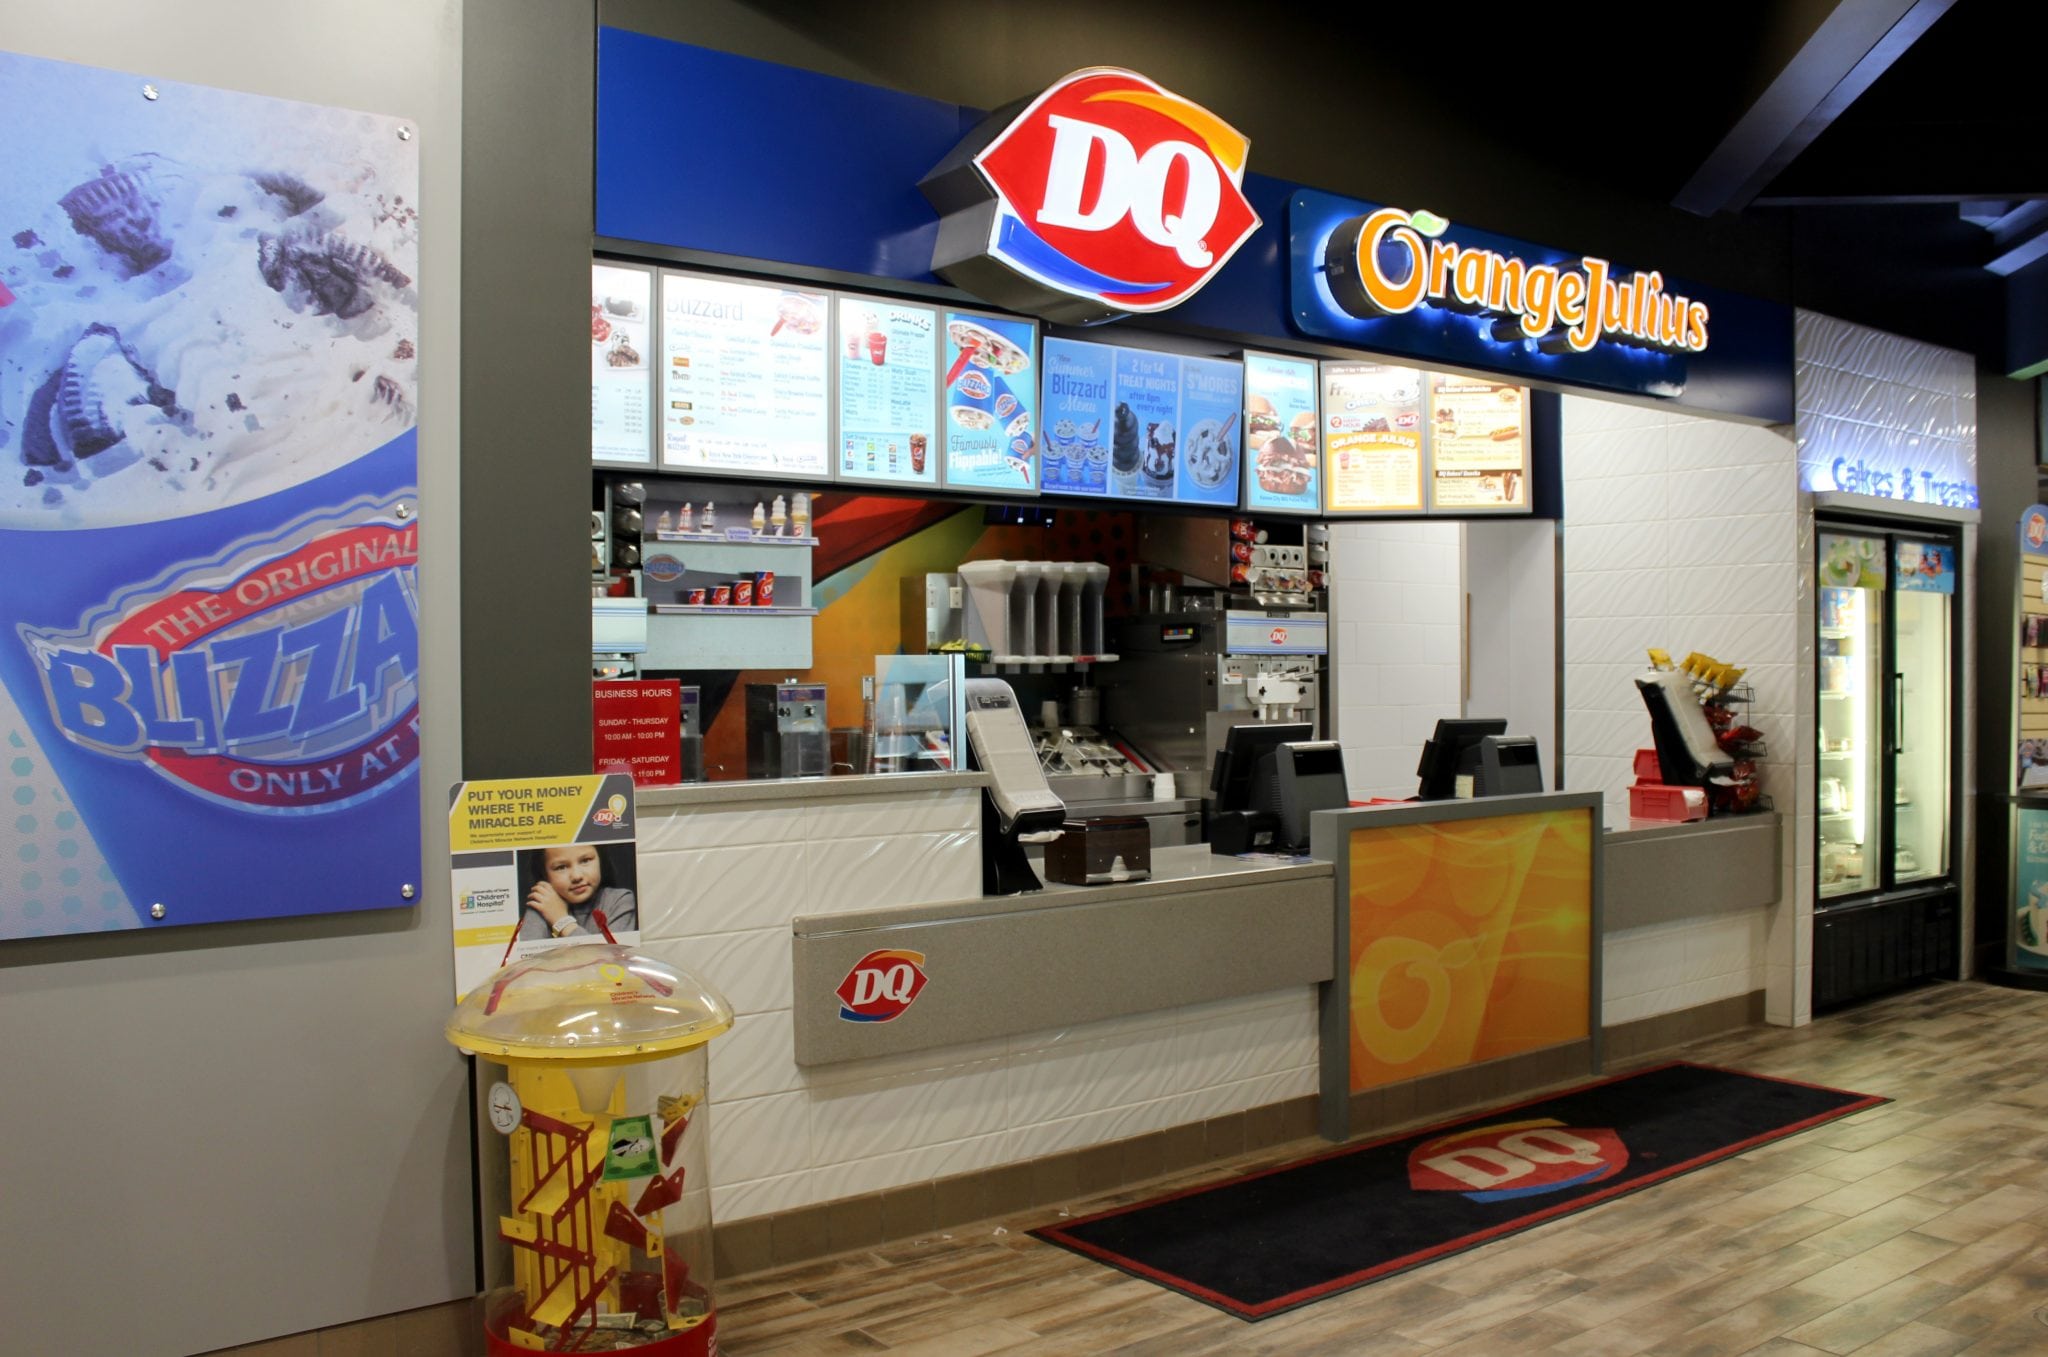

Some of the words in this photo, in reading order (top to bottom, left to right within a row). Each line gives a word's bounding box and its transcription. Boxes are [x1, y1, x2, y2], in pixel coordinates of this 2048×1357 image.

[1036, 113, 1213, 268] DQ
[1052, 373, 1107, 400] Blizzard
[1118, 374, 1144, 388] TREAT
[1145, 378, 1177, 392] NIGHTS
[951, 435, 997, 452] Famously
[1331, 434, 1376, 448] ORANGE
[1379, 434, 1416, 448] JULIUS
[1832, 457, 1893, 498] Cakes
[1901, 467, 1915, 500] &
[236, 529, 418, 609] ORIGINAL
[144, 592, 231, 647] THE
[46, 568, 418, 758] BLIZZA
[595, 689, 638, 698] BUSINESS
[642, 688, 672, 697] HOURS
[633, 717, 669, 725] THURSDAY
[229, 765, 346, 796] ONLY
[359, 733, 402, 781] AT
[632, 756, 669, 764] SATURDAY
[468, 791, 493, 801] PUT
[498, 789, 532, 799] YOUR
[537, 786, 582, 797] MONEY
[468, 803, 515, 815] WHERE
[520, 802, 543, 812] THE
[469, 816, 535, 829] MIRACLES
[538, 814, 566, 825] ARE.
[597, 813, 614, 822] DQ
[477, 893, 510, 901] Children's
[477, 900, 504, 908] Hospital
[852, 964, 914, 1006] DQ
[1419, 1129, 1605, 1189] DQ
